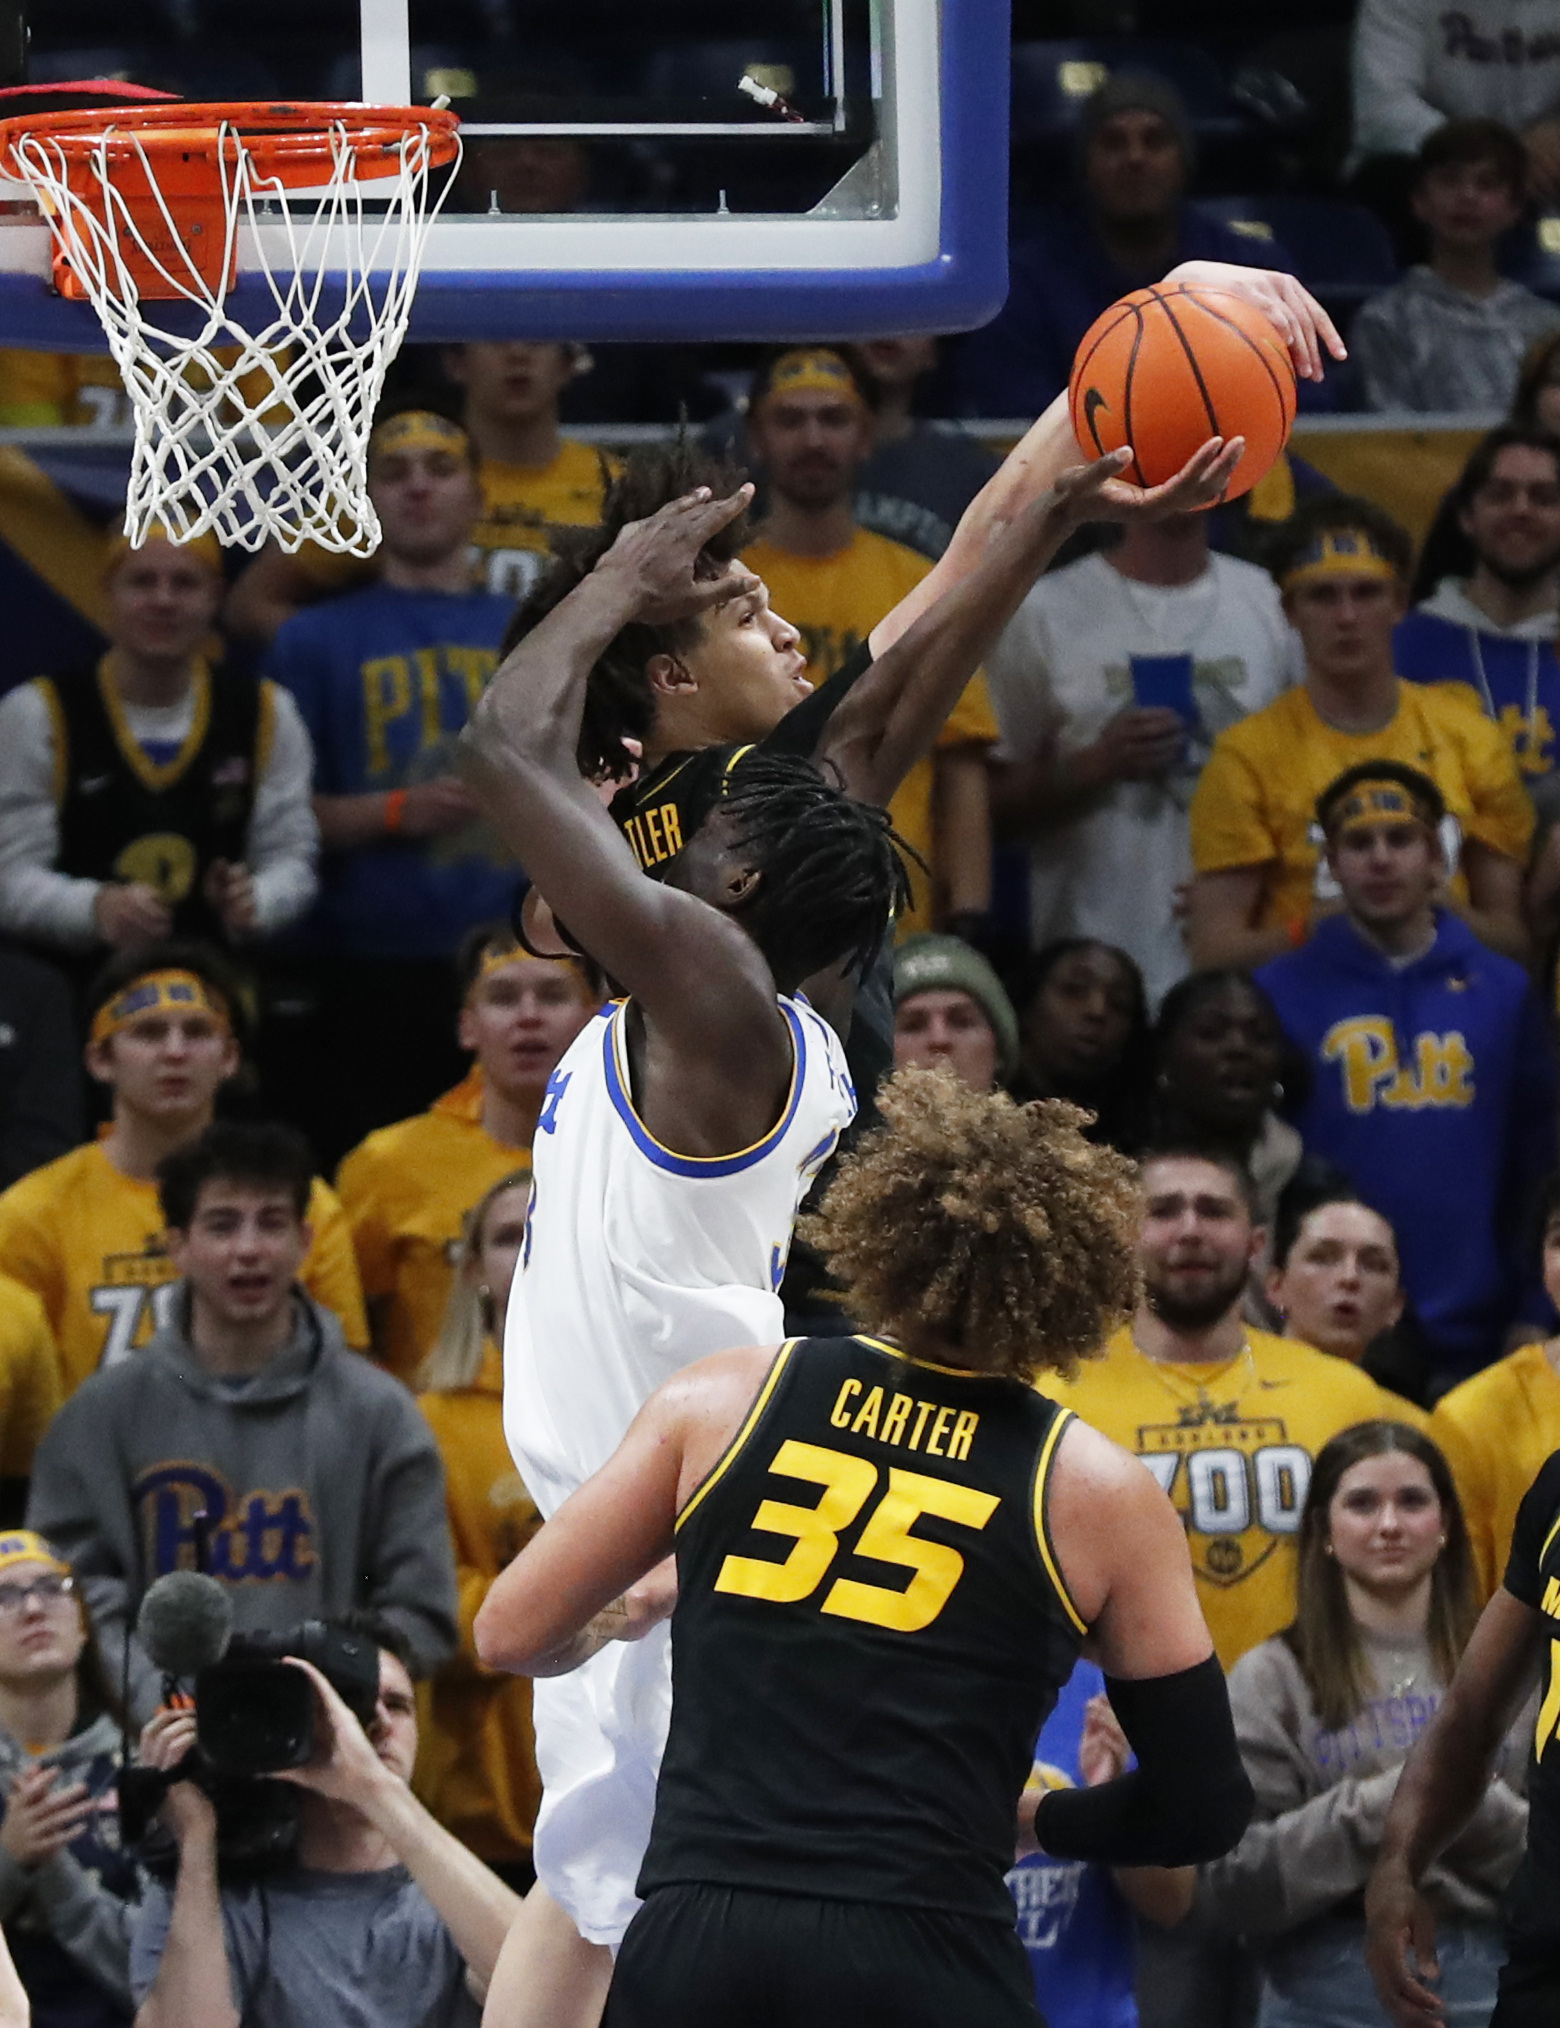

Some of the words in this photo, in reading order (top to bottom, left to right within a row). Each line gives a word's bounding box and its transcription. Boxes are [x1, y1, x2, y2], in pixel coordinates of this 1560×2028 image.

[624, 803, 684, 869] TLER
[1319, 1013, 1477, 1116] Pitt
[829, 1378, 980, 1462] CARTER
[132, 1459, 322, 1587] Pitt
[713, 1439, 1002, 1633] 35
